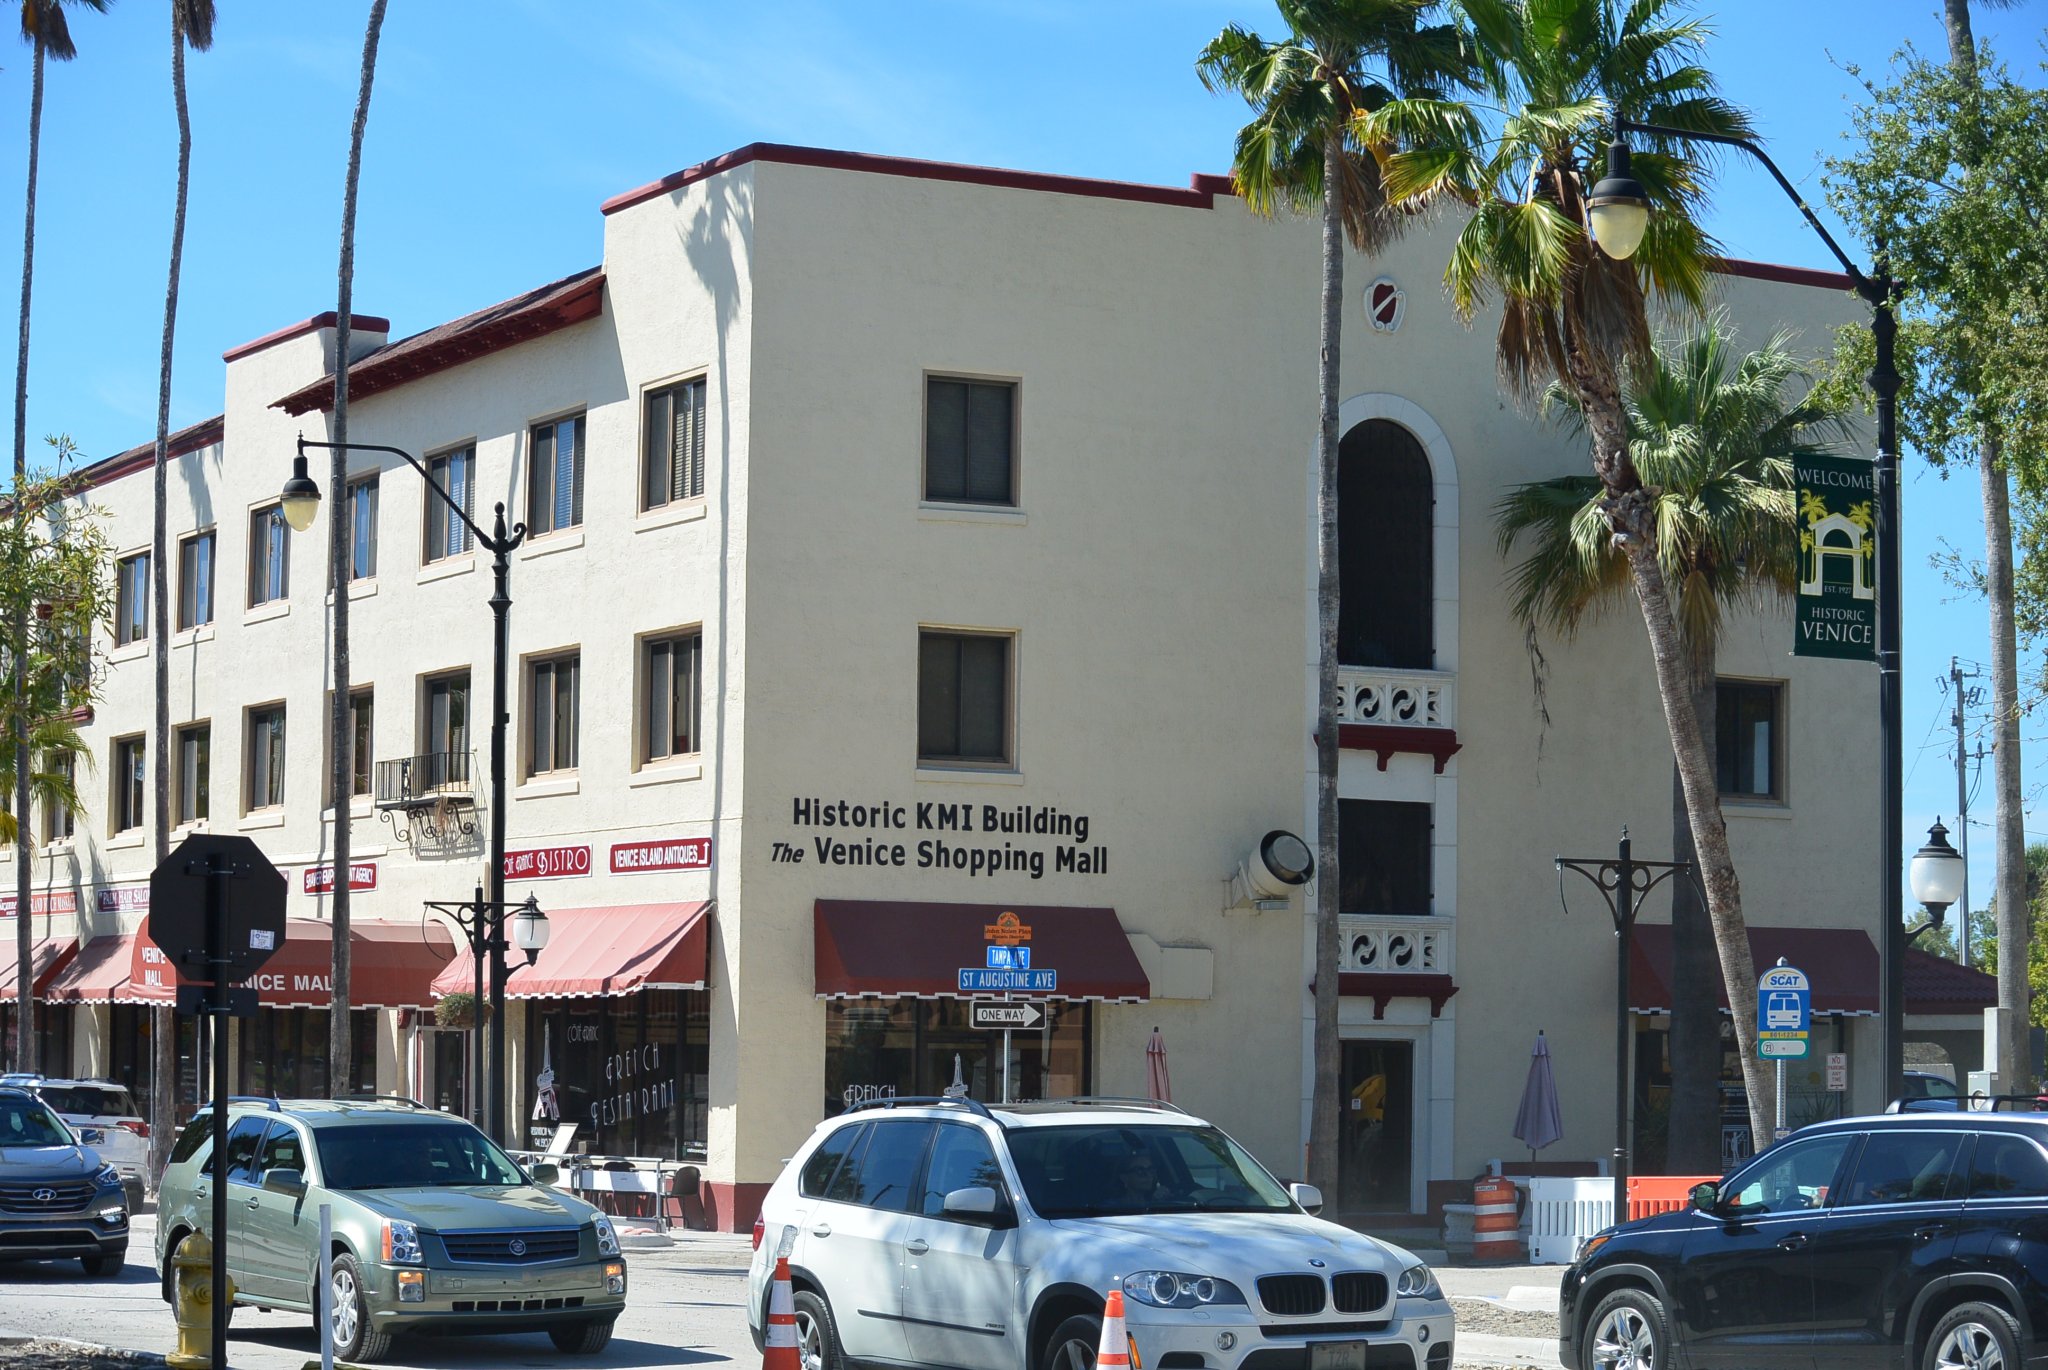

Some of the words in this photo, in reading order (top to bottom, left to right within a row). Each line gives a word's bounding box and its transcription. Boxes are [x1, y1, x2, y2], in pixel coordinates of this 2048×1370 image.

[1797, 467, 1872, 490] WELCOME
[1838, 586, 1852, 595] 1927
[1812, 607, 1865, 622] HISTORIC
[1801, 621, 1872, 644] VENICE
[793, 798, 906, 829] Historic
[917, 802, 973, 831] KMI
[982, 805, 1090, 843] Building
[536, 848, 588, 875] BISTRO
[614, 849, 639, 868] VENICE
[639, 847, 663, 866] ISLAND
[664, 844, 698, 864] ANTIQUES
[771, 842, 805, 864] The
[814, 837, 906, 866] Venice
[916, 840, 1044, 879] Shopping
[1055, 845, 1108, 874] Mall
[118, 890, 132, 904] HAIR
[144, 970, 163, 987] MALL
[294, 975, 333, 991] MAL
[962, 972, 974, 987] ST
[979, 972, 1029, 987] AUGUSTINE
[1035, 973, 1053, 987] AVE
[1770, 976, 1800, 986] SCAT
[981, 1009, 1001, 1020] ONE
[1004, 1009, 1025, 1020] WAY
[1831, 1056, 1841, 1065] NO
[843, 1084, 896, 1106] FRENCH
